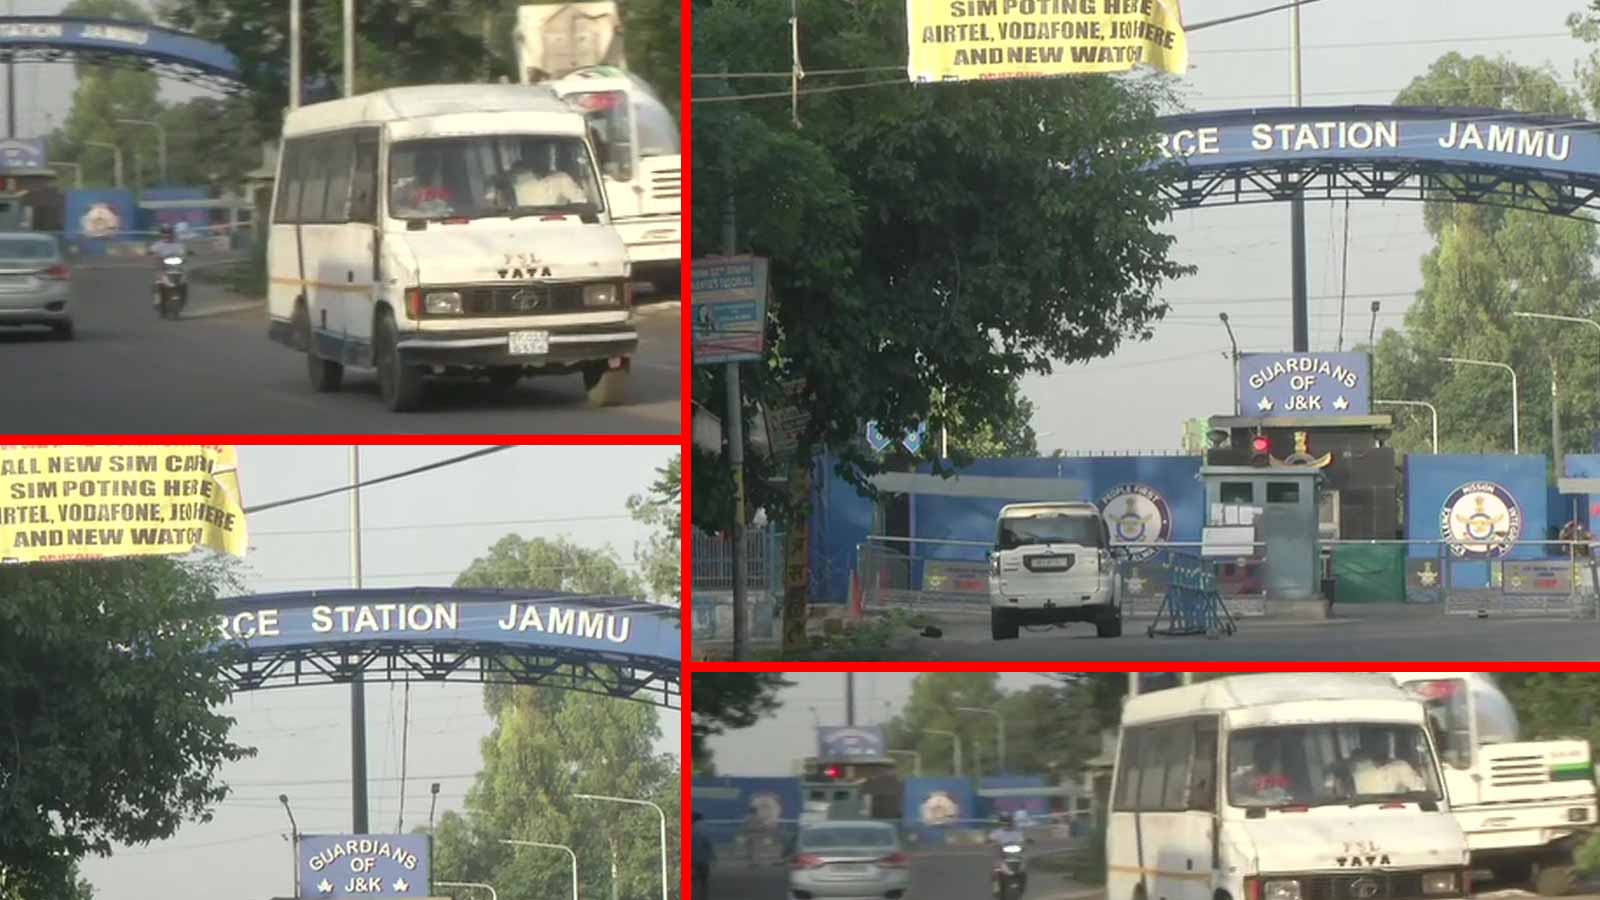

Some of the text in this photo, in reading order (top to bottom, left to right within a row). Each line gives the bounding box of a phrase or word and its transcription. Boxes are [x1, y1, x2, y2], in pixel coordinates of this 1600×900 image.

[951, 0, 997, 18] SIM
[1003, 0, 1096, 16] POTING
[953, 48, 1002, 66] AND
[1008, 47, 1064, 64] NEW
[1251, 120, 1398, 152] STATION
[1438, 120, 1571, 162] JAMMU
[497, 266, 552, 279] TATA
[1249, 357, 1358, 389] GUARDIANS
[1290, 375, 1315, 390] OF
[1284, 395, 1322, 410] J&K
[1, 456, 41, 475] ALL
[48, 455, 102, 474] NEW
[109, 454, 158, 473] SIM
[10, 481, 57, 500] SIM
[63, 479, 156, 498] POTING
[13, 528, 62, 547] AND
[67, 527, 124, 545] NEW
[311, 602, 459, 634] STATION
[498, 603, 631, 643] JAMMU
[309, 839, 418, 872] GUARDIANS
[350, 857, 376, 872] OF
[1336, 854, 1391, 867] TATA
[344, 877, 382, 892] J&K
